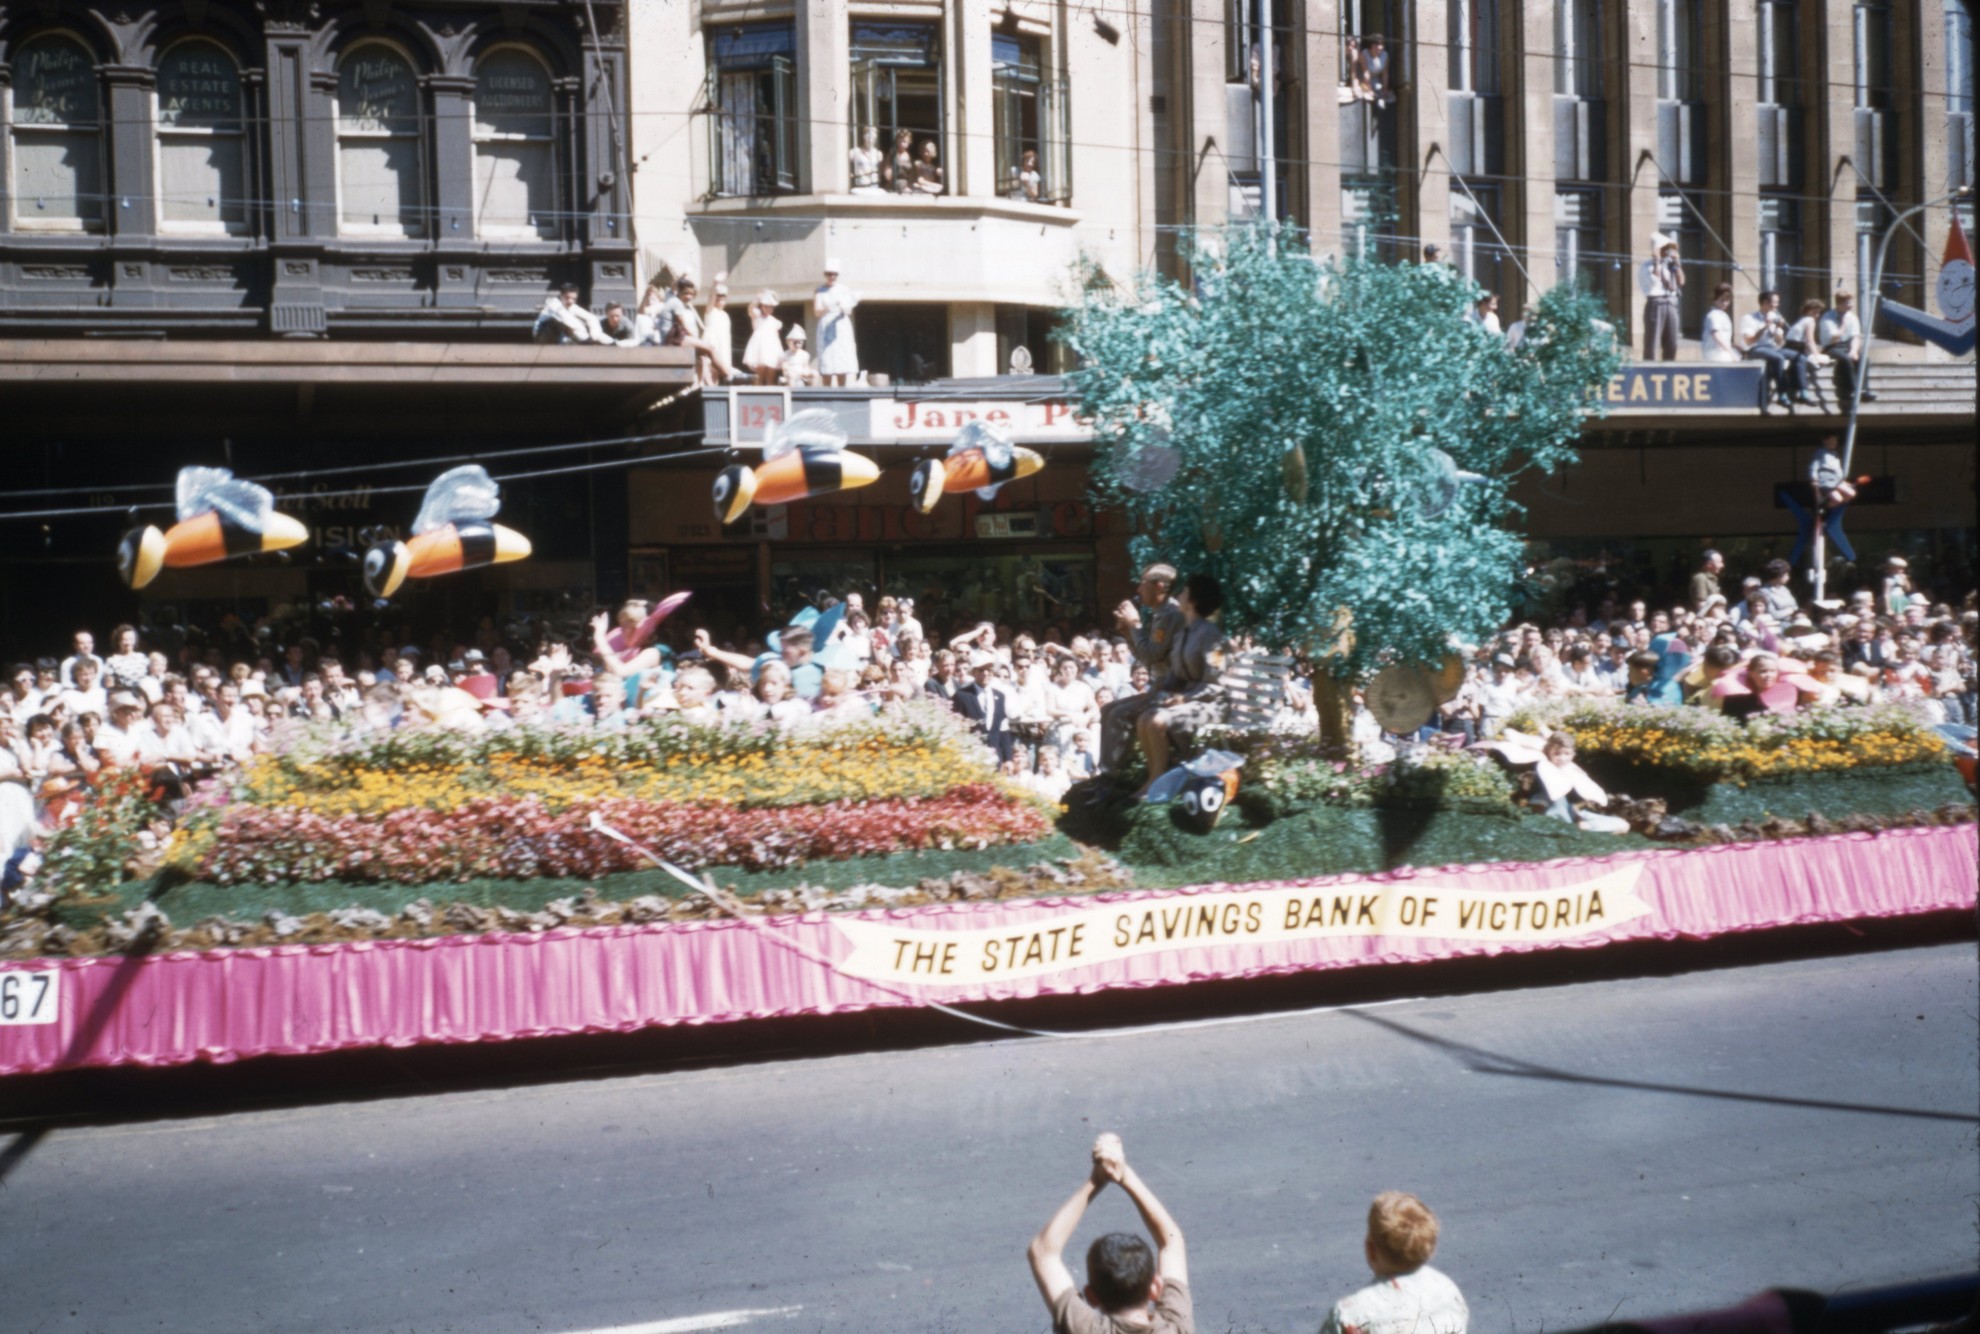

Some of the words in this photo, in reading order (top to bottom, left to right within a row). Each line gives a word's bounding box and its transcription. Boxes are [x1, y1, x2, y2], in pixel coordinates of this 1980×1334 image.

[179, 61, 221, 75] REAL
[169, 80, 230, 94] ESTATE
[169, 98, 231, 112] AGENTS
[742, 405, 782, 427] 123
[894, 402, 1011, 429] Jane
[893, 940, 957, 974] THE
[981, 924, 1085, 972] STATE
[1114, 902, 1263, 948] SAVINGS
[1284, 896, 1380, 930] BANK
[1400, 896, 1438, 926] OF
[1458, 890, 1604, 931] VICTORIA
[2, 975, 49, 1019] 67
